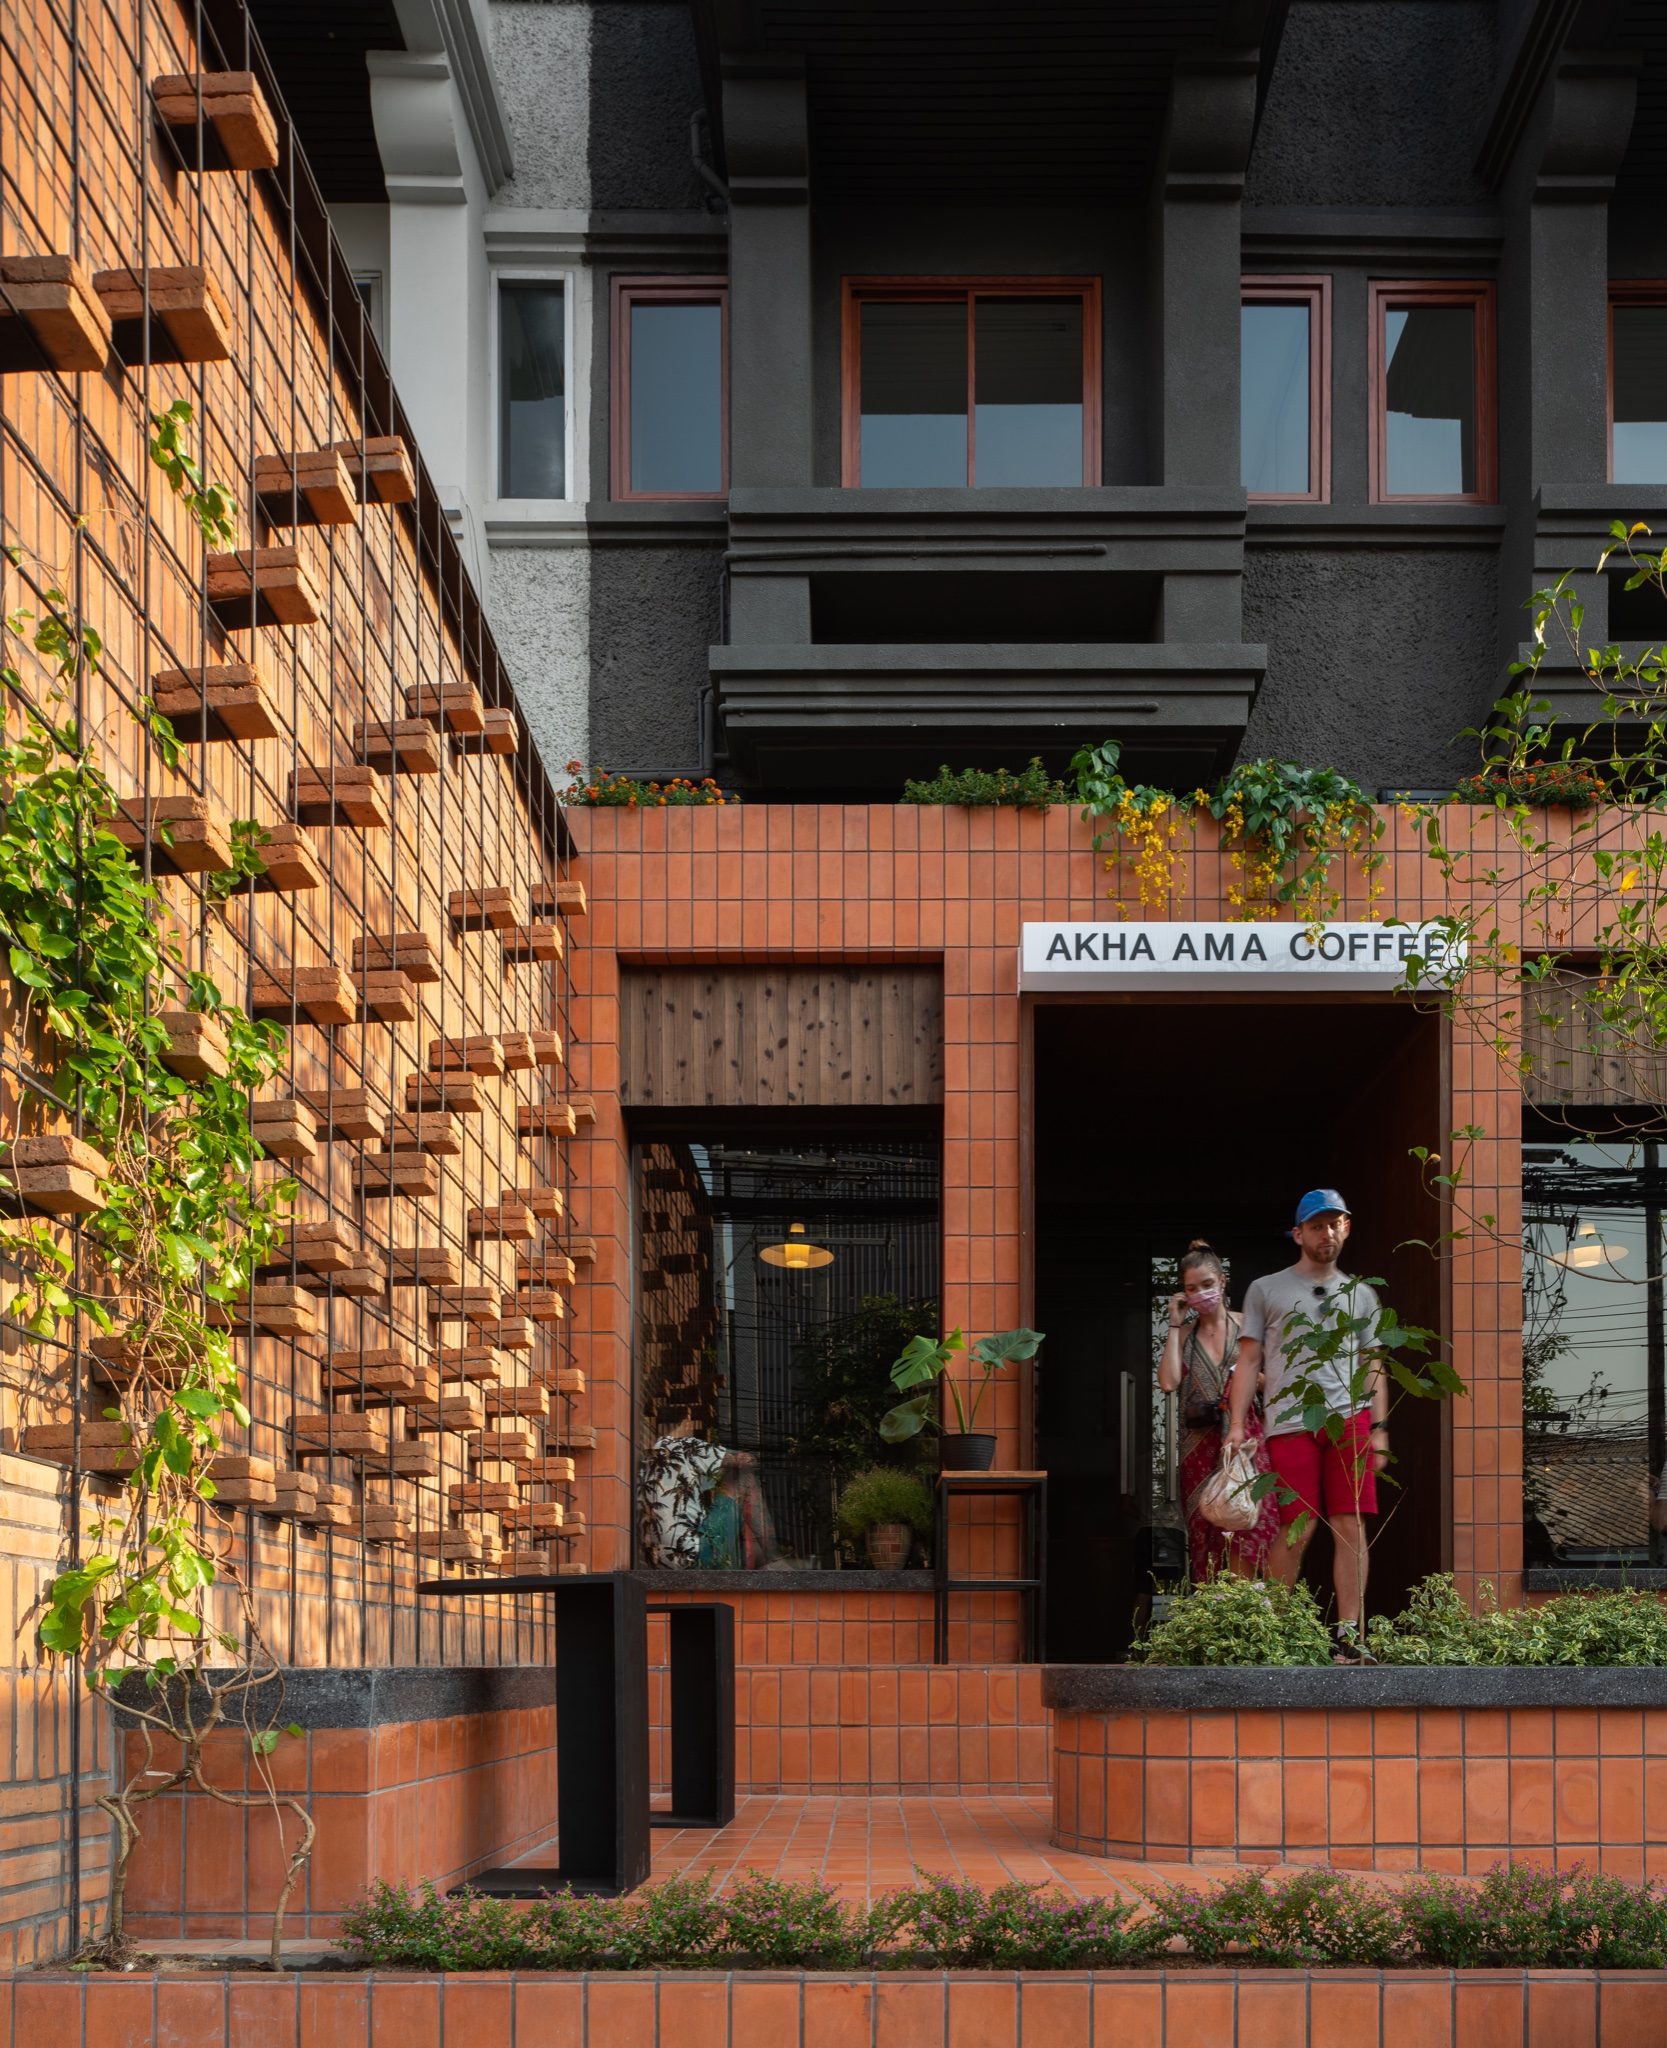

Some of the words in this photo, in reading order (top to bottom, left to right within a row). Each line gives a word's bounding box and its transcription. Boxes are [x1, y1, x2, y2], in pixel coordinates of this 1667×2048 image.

[1046, 933, 1156, 961] AKHA
[1172, 933, 1268, 961] AMA
[1290, 932, 1446, 961] COFFEE
